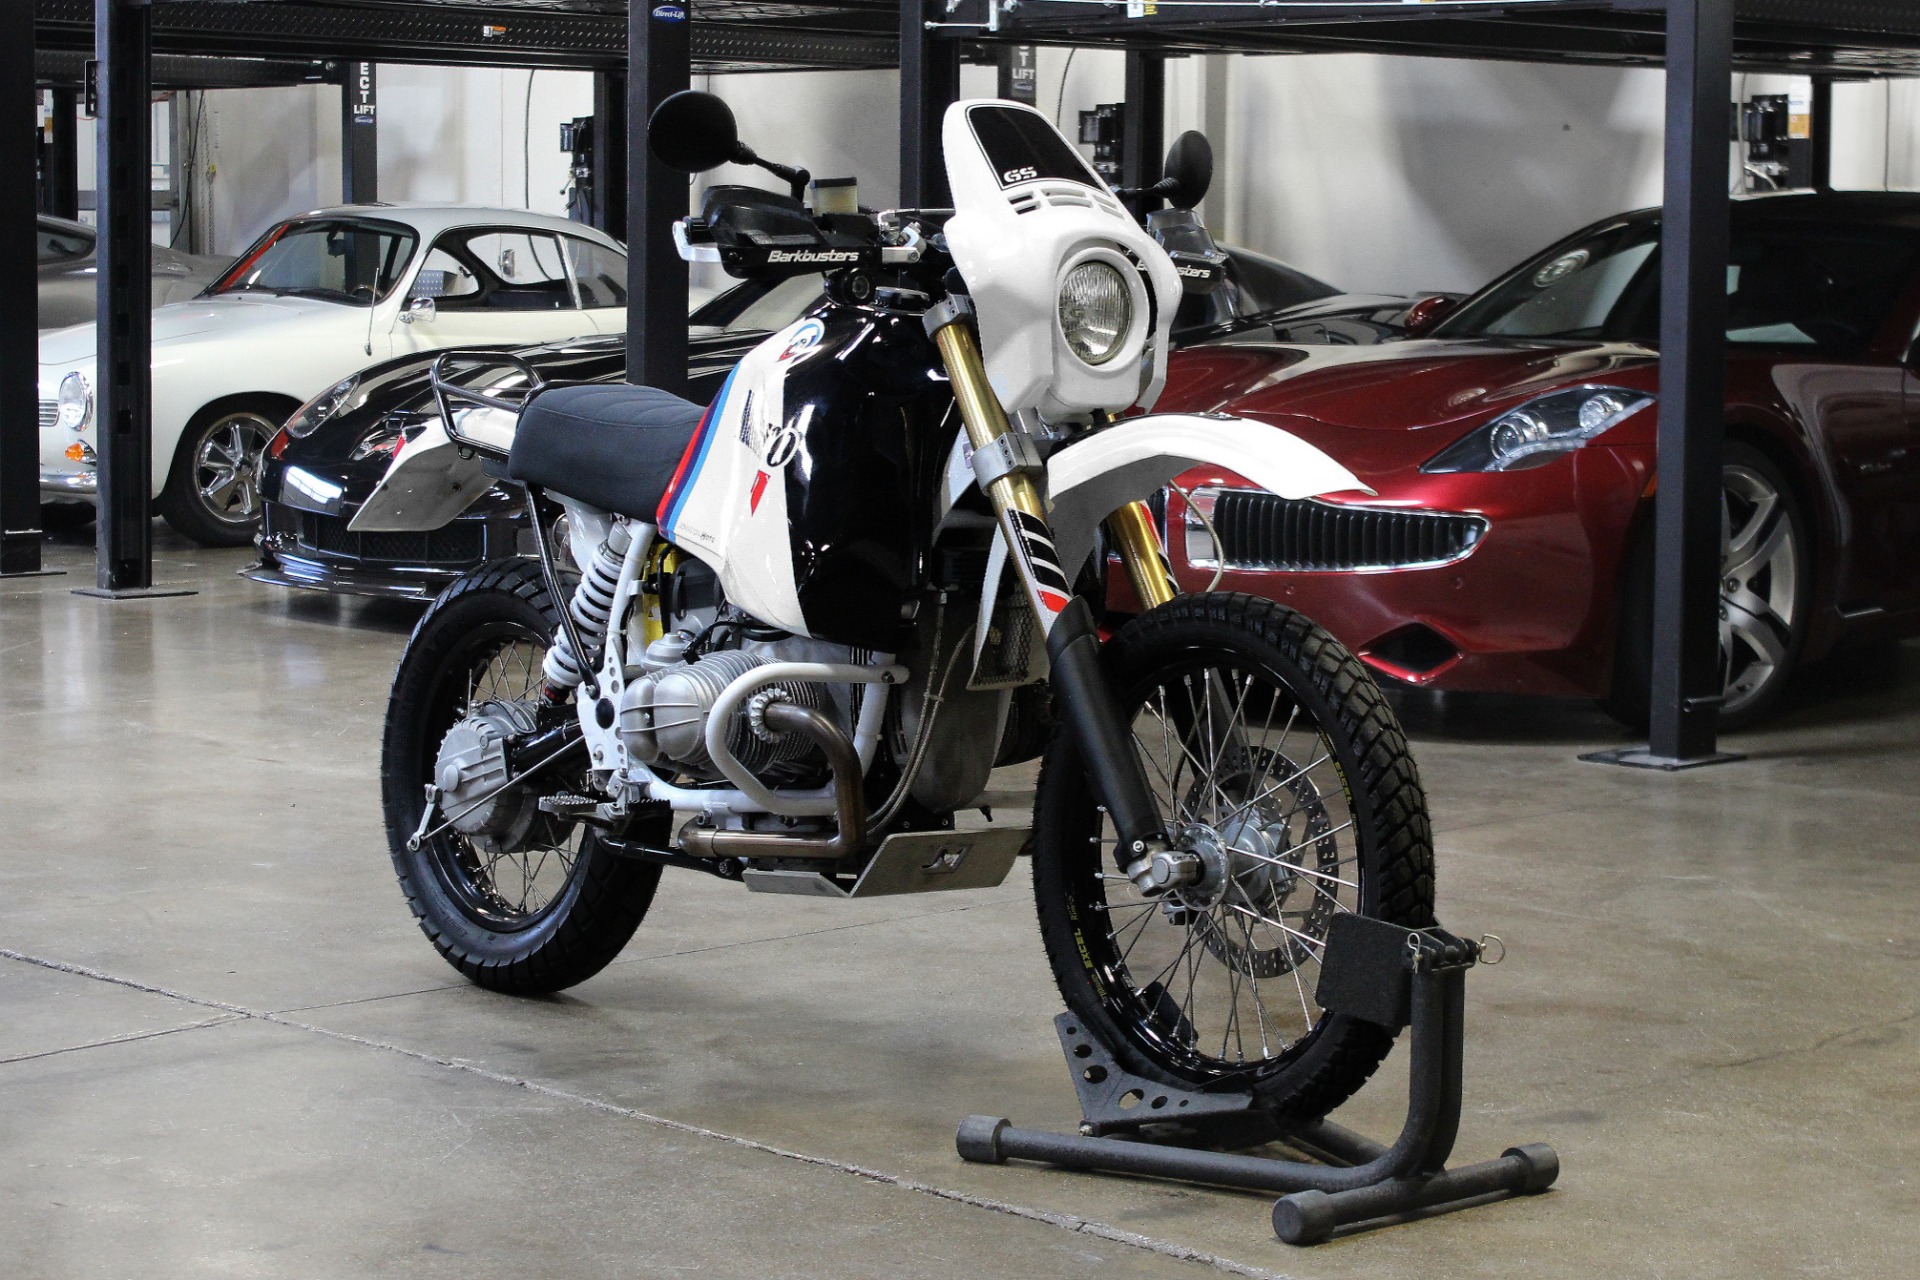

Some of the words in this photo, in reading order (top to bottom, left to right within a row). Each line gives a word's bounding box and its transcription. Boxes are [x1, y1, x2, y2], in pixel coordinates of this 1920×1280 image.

[1012, 68, 1035, 80] LIFT
[353, 104, 376, 115] LIFT
[1003, 166, 1038, 183] GS
[767, 249, 860, 263] Barkbusters
[1074, 928, 1094, 969] EXCEL
